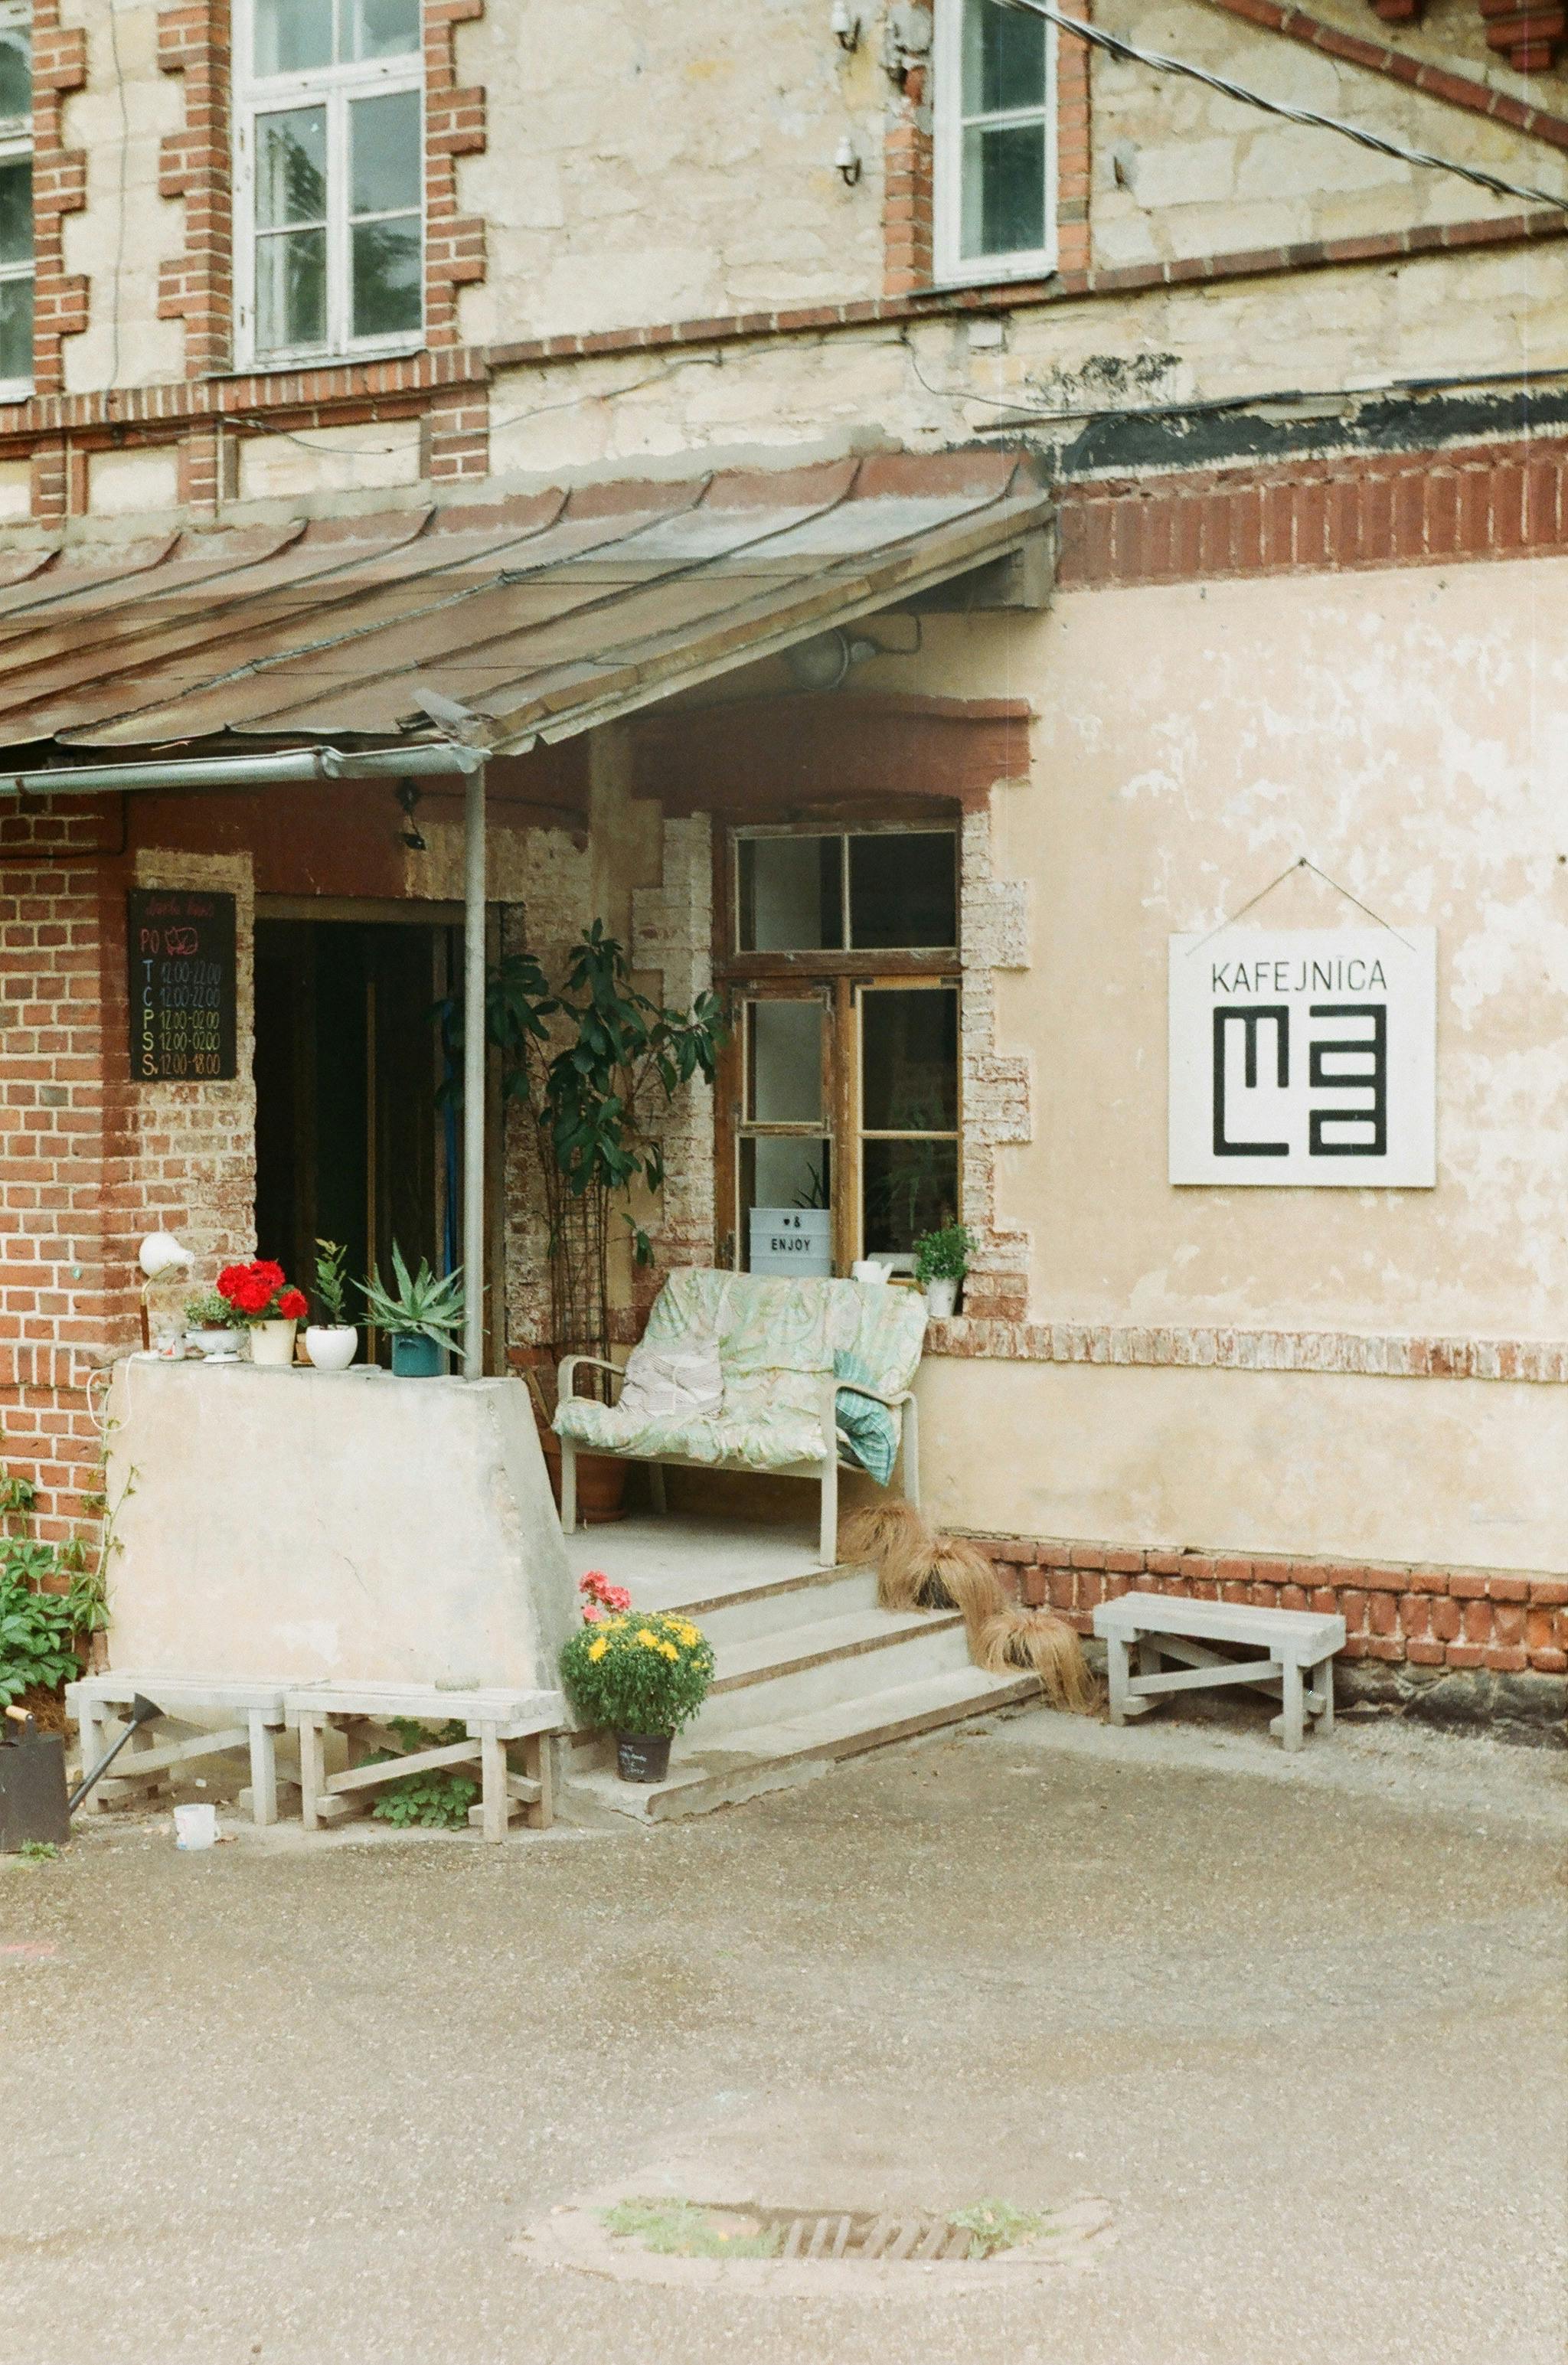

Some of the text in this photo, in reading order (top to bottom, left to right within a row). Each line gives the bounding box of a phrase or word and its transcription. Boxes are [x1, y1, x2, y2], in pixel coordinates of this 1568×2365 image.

[142, 959, 154, 983] T
[142, 985, 153, 1007] C
[143, 1008, 155, 1030] P
[142, 1031, 155, 1051] S
[771, 1238, 811, 1251] ENJOY
